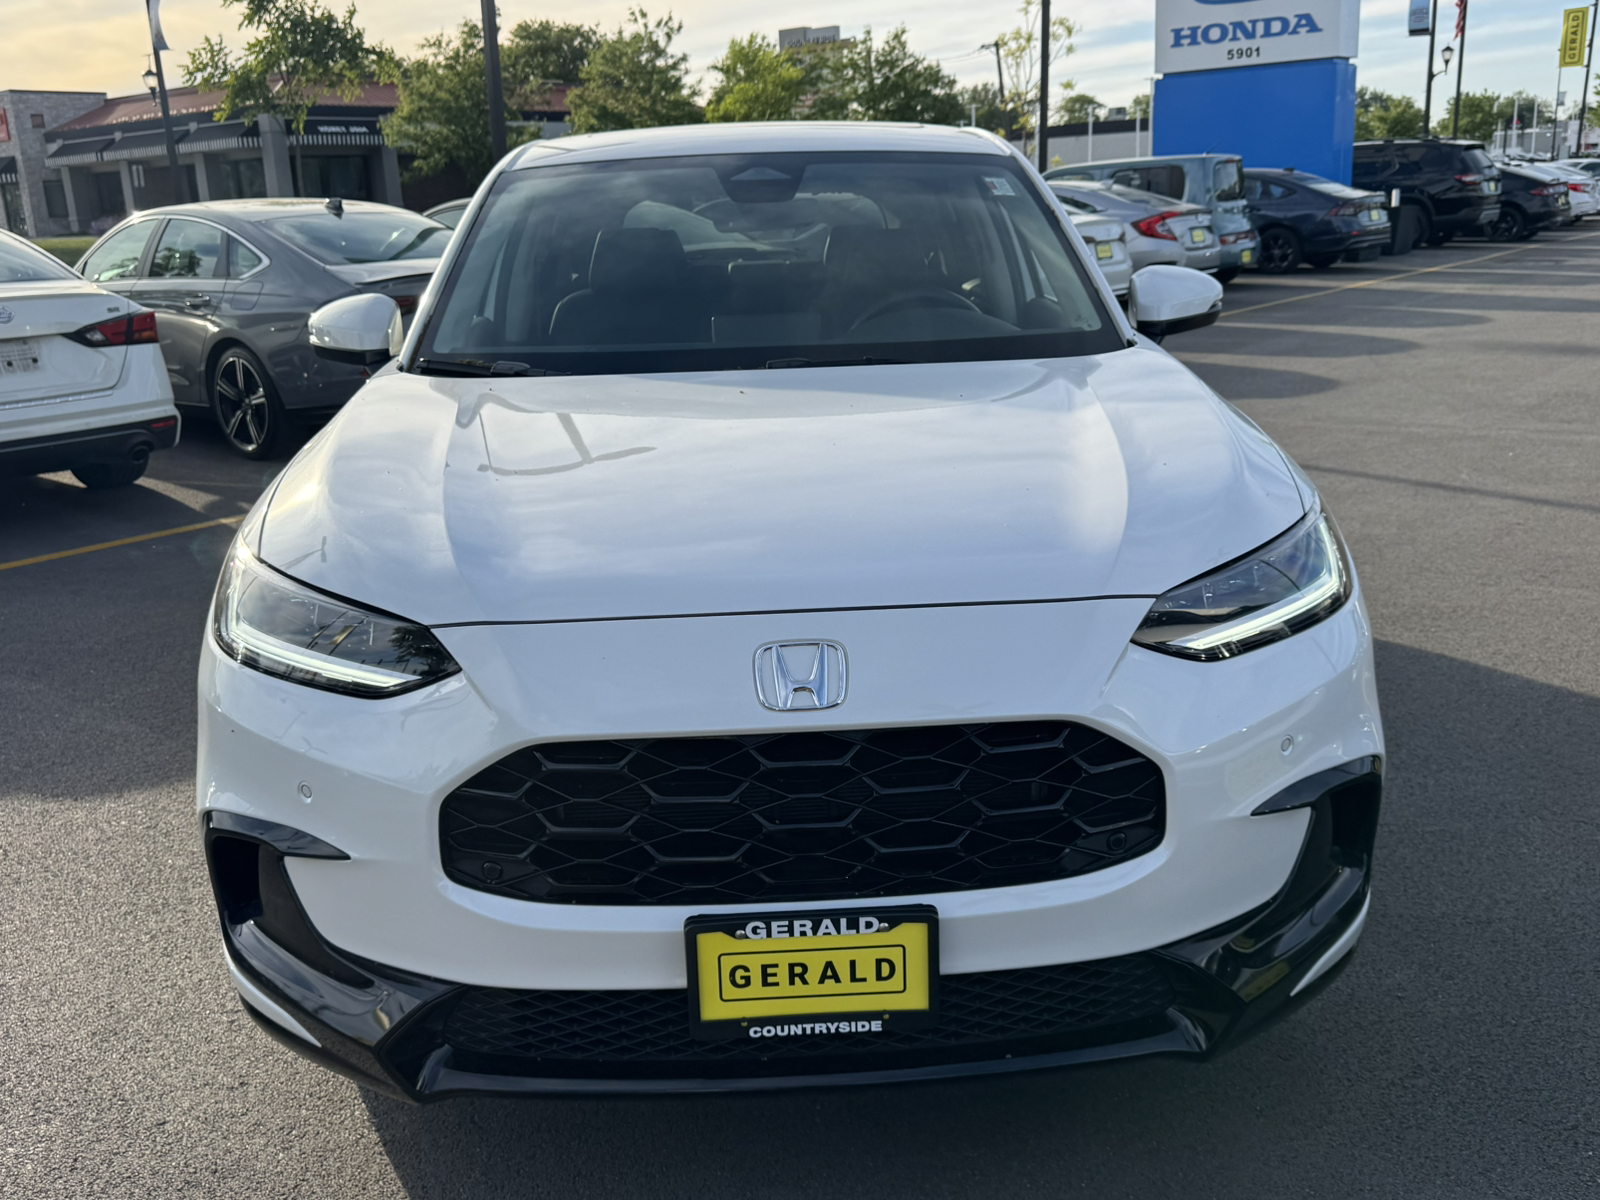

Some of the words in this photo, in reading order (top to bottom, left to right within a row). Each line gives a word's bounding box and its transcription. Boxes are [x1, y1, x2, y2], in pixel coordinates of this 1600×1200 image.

[1170, 13, 1323, 48] HONDA
[1568, 15, 1580, 60] GERALD
[1227, 46, 1261, 60] 5901
[745, 917, 880, 939] GERALD
[729, 958, 896, 988] GERALD
[749, 1020, 883, 1038] COUNTRYSIDE
